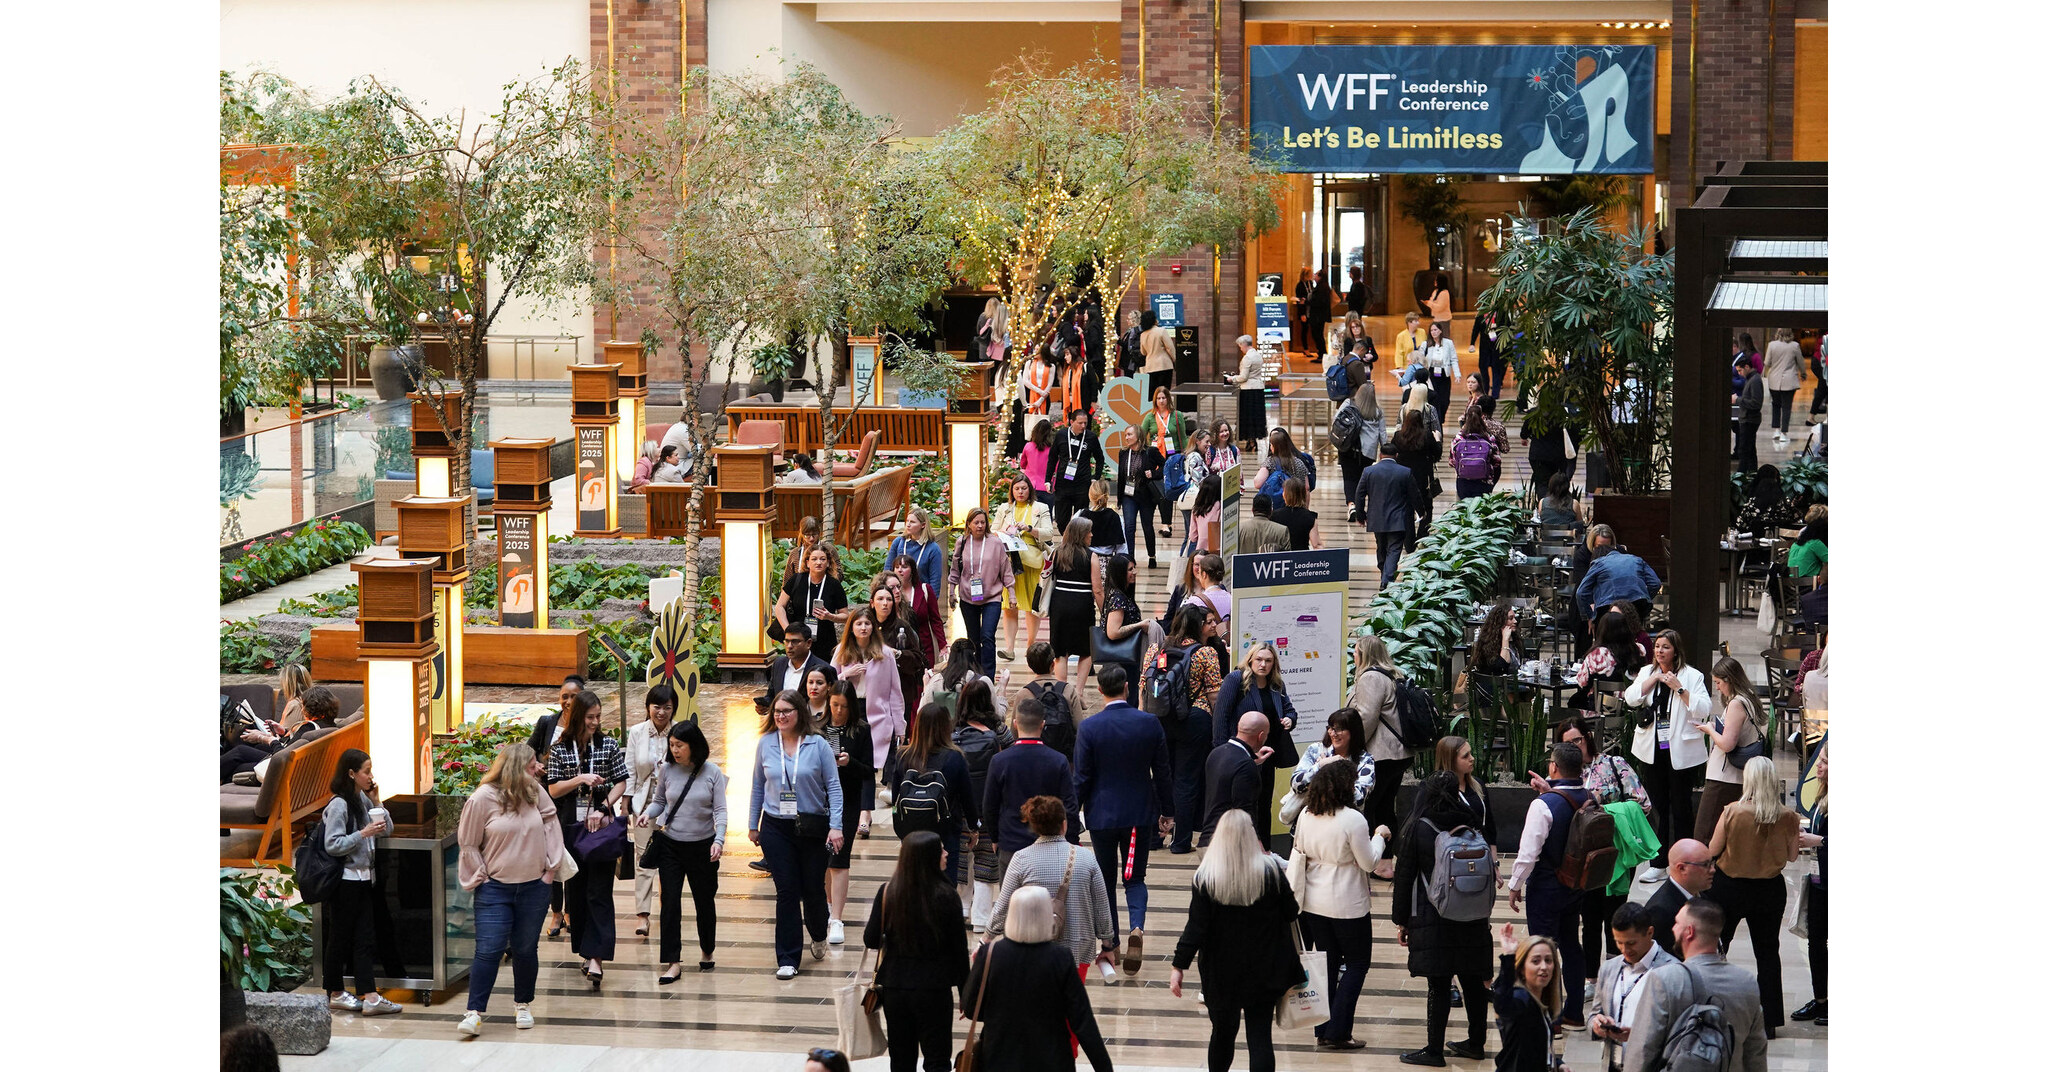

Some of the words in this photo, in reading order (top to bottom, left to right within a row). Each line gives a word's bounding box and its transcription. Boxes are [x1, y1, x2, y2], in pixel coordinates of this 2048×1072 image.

[1400, 79, 1488, 97] Leadership
[1399, 97, 1489, 112] Conference
[1283, 126, 1340, 149] Let's
[1347, 126, 1381, 149] Be
[1387, 125, 1503, 150] Limitless
[857, 362, 871, 398] WFF
[580, 430, 603, 439] WFF
[504, 517, 530, 529] WFF
[505, 541, 530, 550] 2025
[1294, 561, 1330, 569] Leadership
[1294, 569, 1330, 578] Conference
[1298, 990, 1315, 998] BOLD
